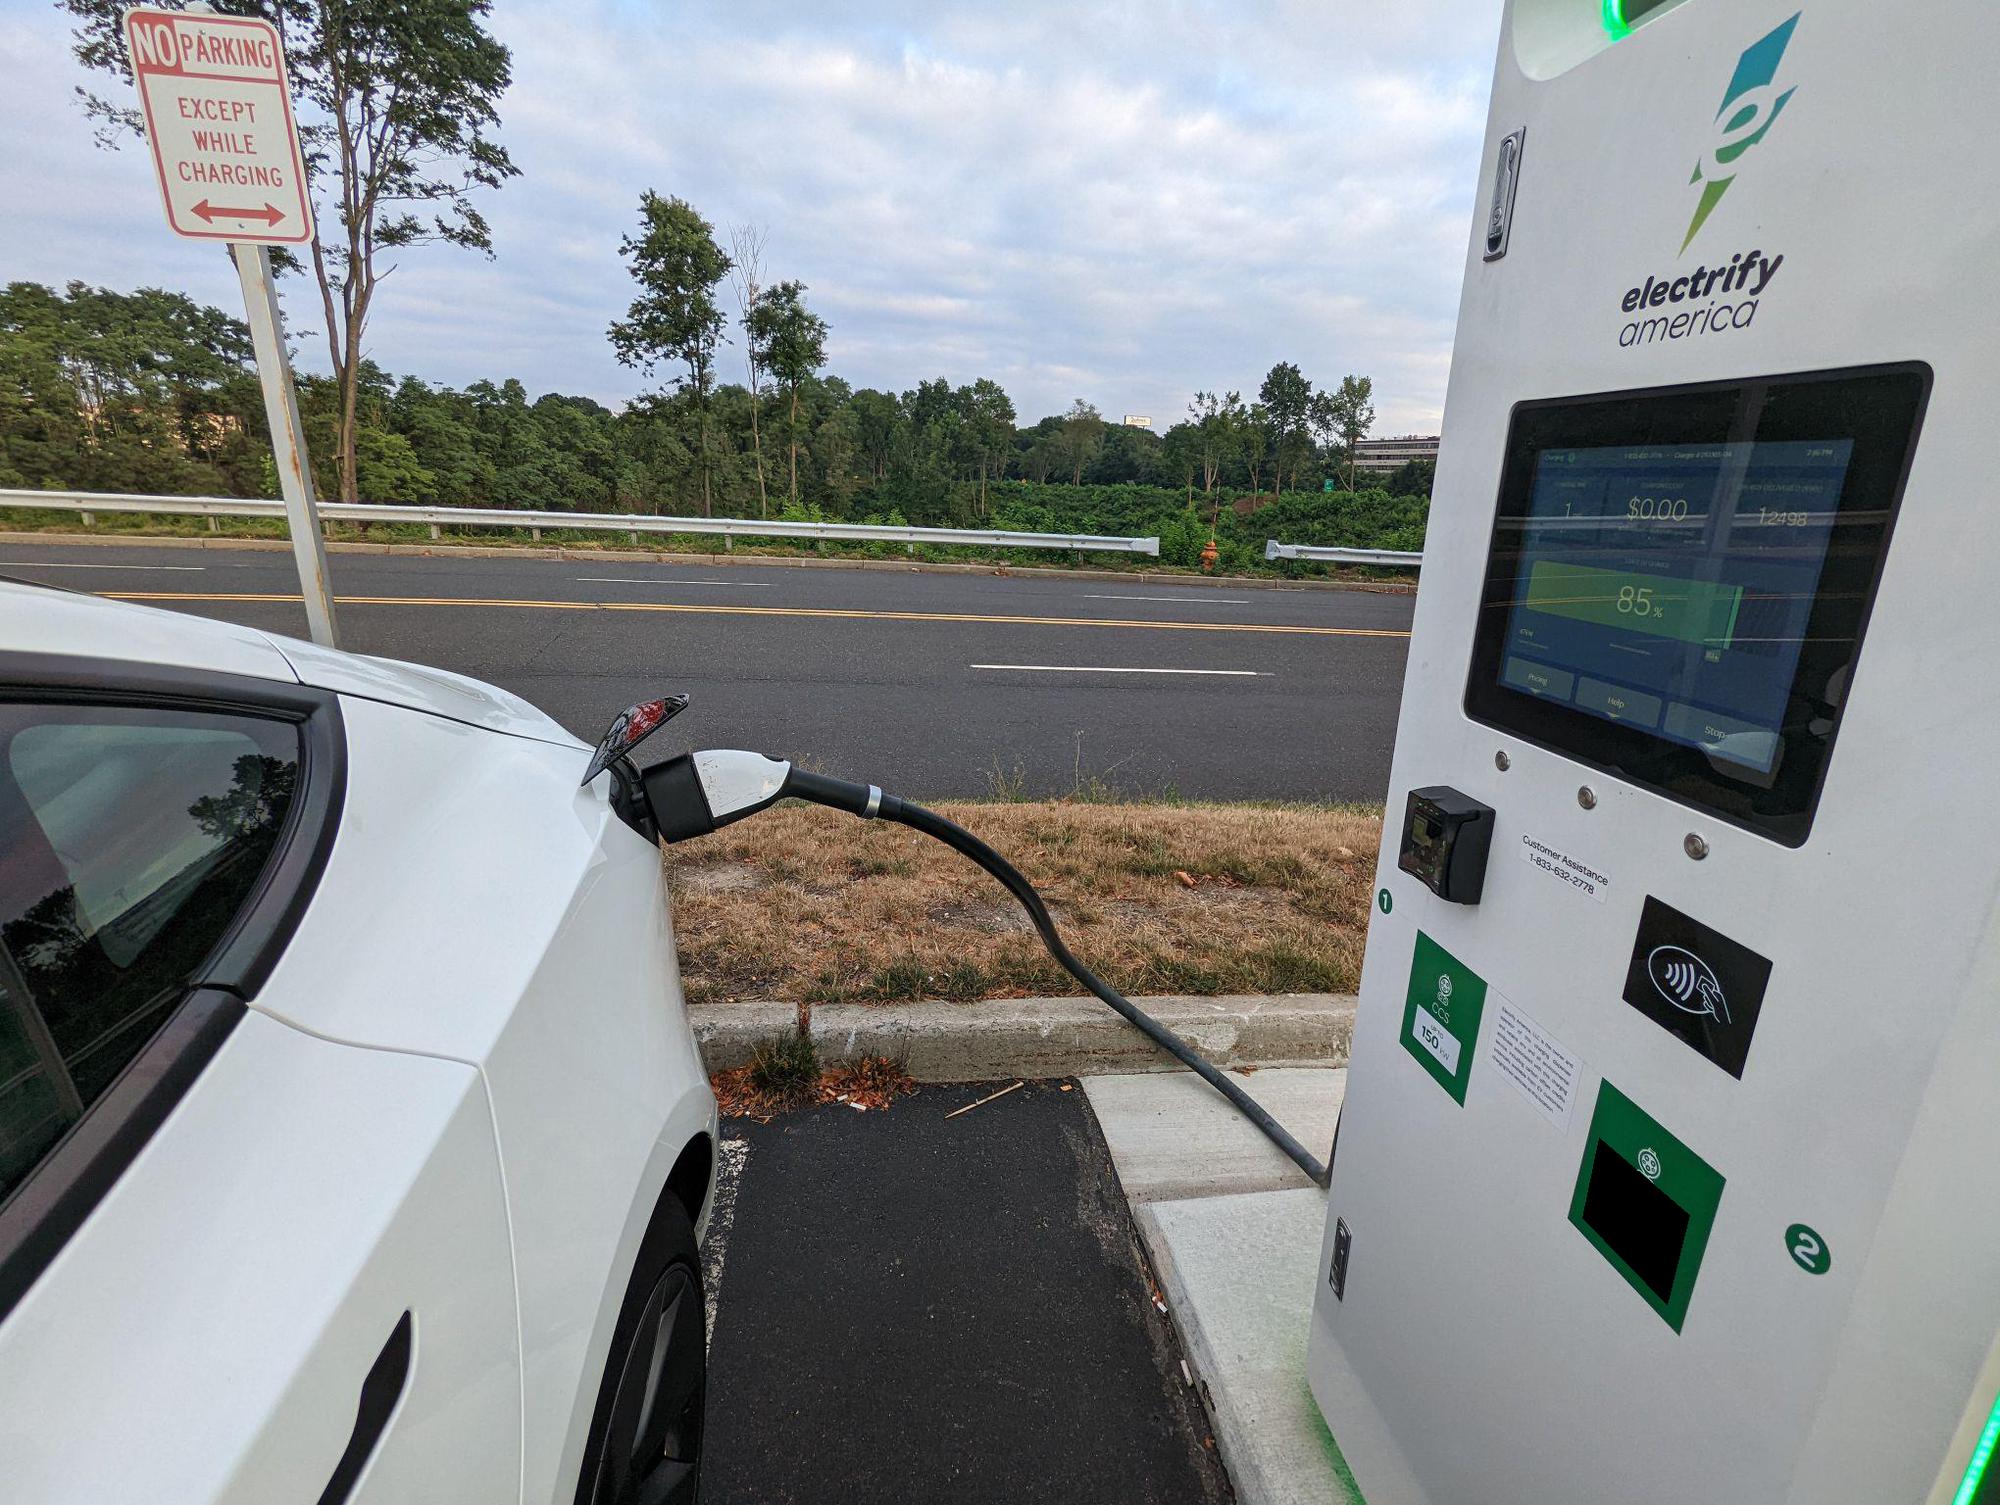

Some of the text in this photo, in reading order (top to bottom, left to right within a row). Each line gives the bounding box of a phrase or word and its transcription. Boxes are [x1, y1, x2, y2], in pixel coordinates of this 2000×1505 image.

[131, 22, 273, 69] NO PARKING
[177, 96, 256, 123] EXCEPT
[192, 130, 257, 155] WHILE
[178, 161, 283, 188] CHARGING
[1621, 250, 1784, 312] electrify
[1619, 300, 1759, 347] america
[1627, 496, 1688, 521] $0.00
[1704, 726, 1726, 740] Stop
[1522, 835, 1608, 886] Customer Assistance
[1529, 853, 1594, 895] 1-833-632-2778
[1431, 1002, 1449, 1024] CCS
[1421, 1025, 1439, 1049] 150
[1794, 1232, 1820, 1268] 2
